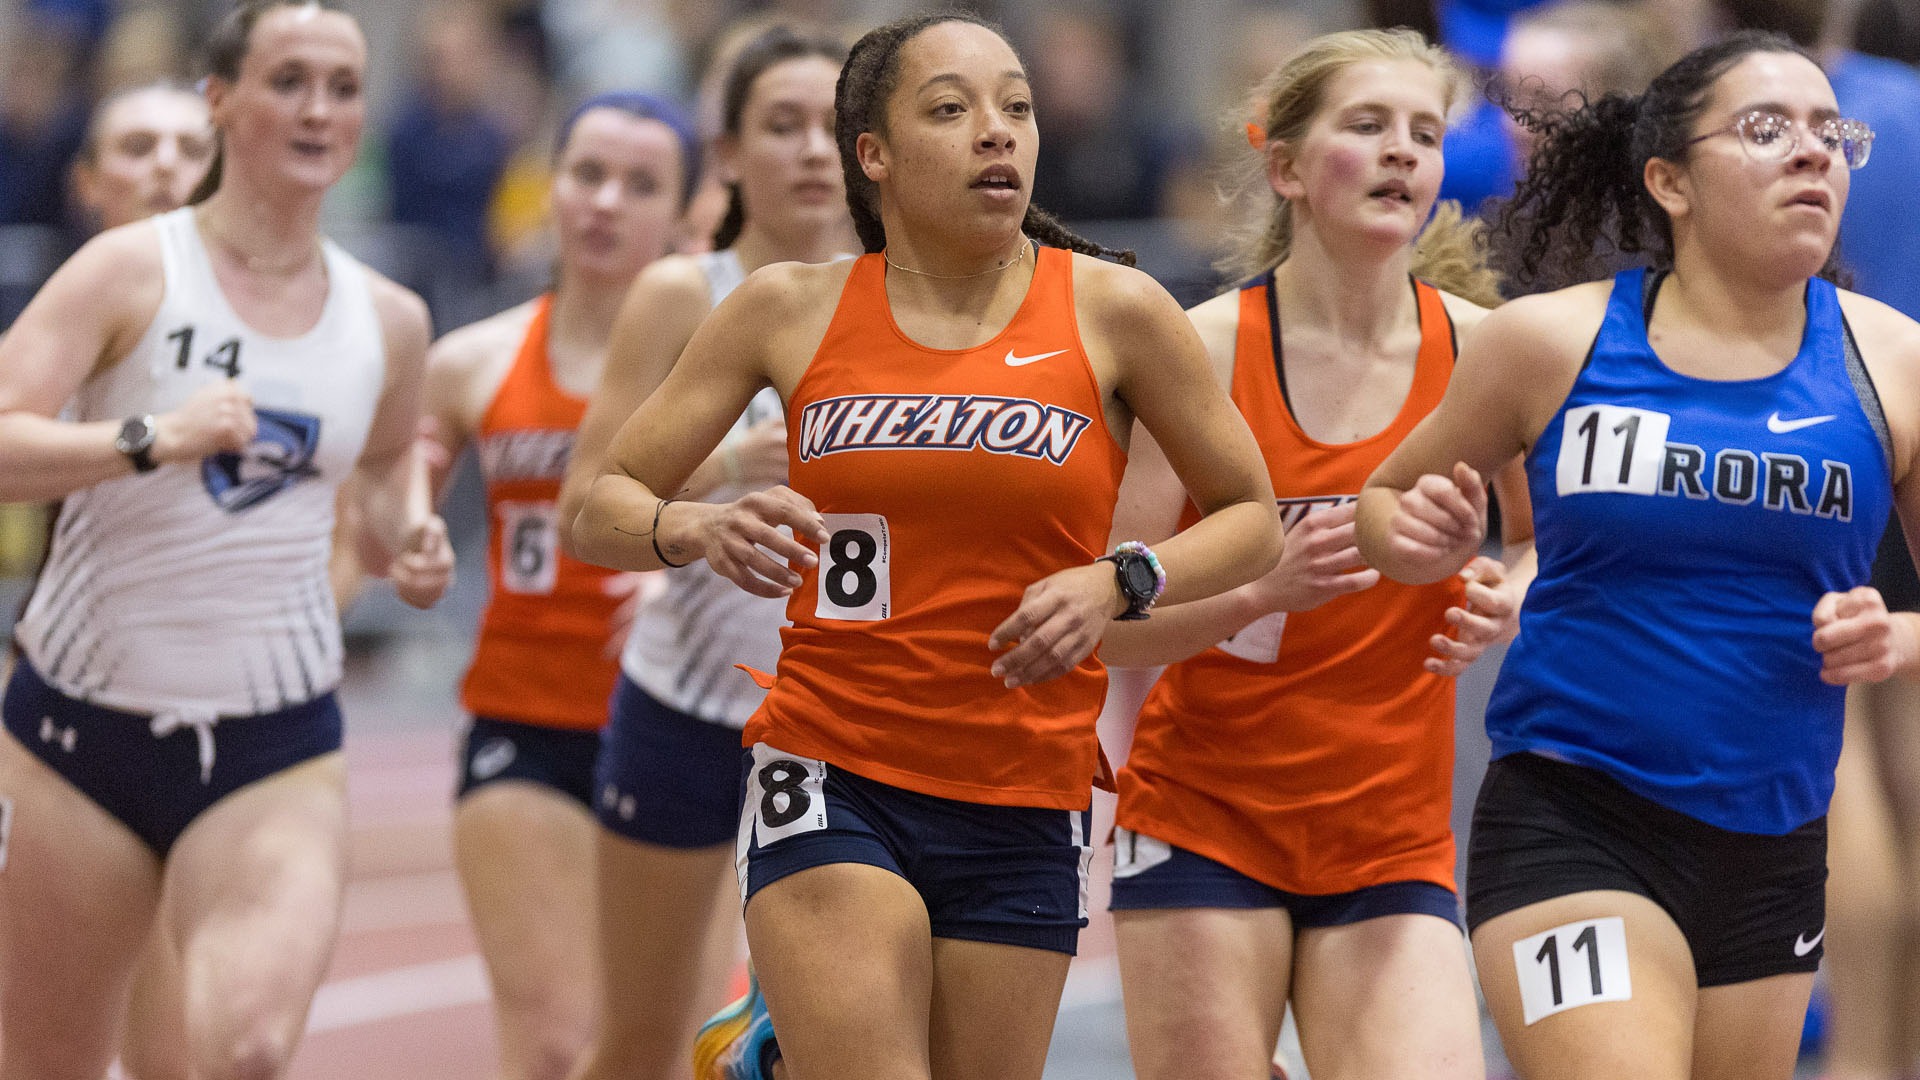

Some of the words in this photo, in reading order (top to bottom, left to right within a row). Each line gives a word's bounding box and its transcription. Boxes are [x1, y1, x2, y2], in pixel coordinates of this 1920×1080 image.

[167, 324, 242, 379] 14
[799, 393, 1093, 466] WHEATON
[1568, 411, 1642, 486] 11
[1657, 441, 1853, 523] RORA
[511, 516, 547, 577] 6
[825, 529, 877, 608] 8
[758, 760, 811, 829] 8
[1536, 925, 1603, 1007] 11
